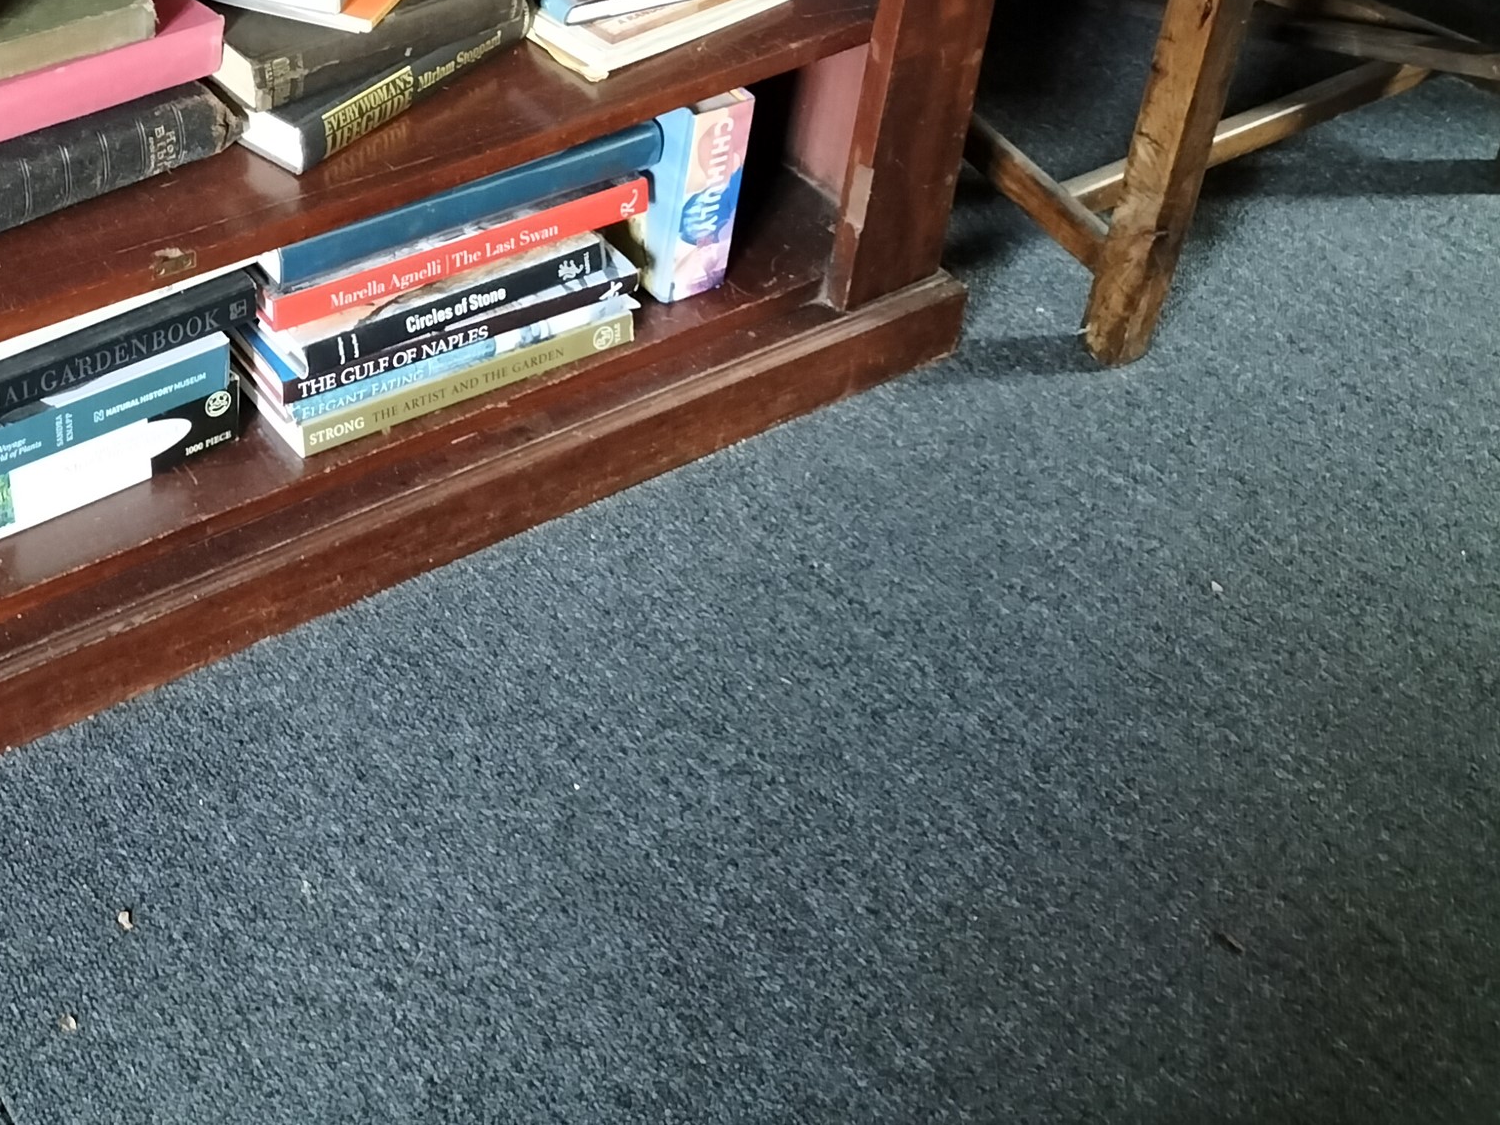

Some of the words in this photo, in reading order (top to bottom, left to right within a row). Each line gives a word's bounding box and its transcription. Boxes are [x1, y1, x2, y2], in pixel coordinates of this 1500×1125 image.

[456, 30, 502, 70] Stoppard
[329, 280, 386, 309] Marella
[388, 258, 442, 289] Agnelli
[452, 250, 482, 269] The
[485, 237, 516, 258] Last
[519, 225, 559, 247] Swan
[405, 306, 454, 334] Circles
[454, 296, 468, 317] of
[468, 287, 507, 311] Stone
[297, 377, 337, 399] THE
[340, 358, 390, 385] GULF
[393, 348, 418, 368] OF
[420, 325, 489, 359] NAPLES
[105, 397, 140, 417] NATURAL
[140, 385, 174, 404] HISTORY
[173, 372, 207, 391] MUSEUM
[301, 388, 366, 420] ELEGANT
[371, 369, 425, 397] EATING
[309, 416, 366, 446] STRONG
[373, 403, 398, 424] THE
[403, 388, 447, 412] ARTIST
[451, 377, 480, 396] AND
[482, 367, 509, 384] THE
[511, 347, 565, 374] GARDEN
[0, 437, 28, 459] Voyage
[8, 448, 18, 461] of
[18, 440, 42, 457] Plants
[185, 441, 204, 457] 1000
[205, 430, 233, 448] PIECE
